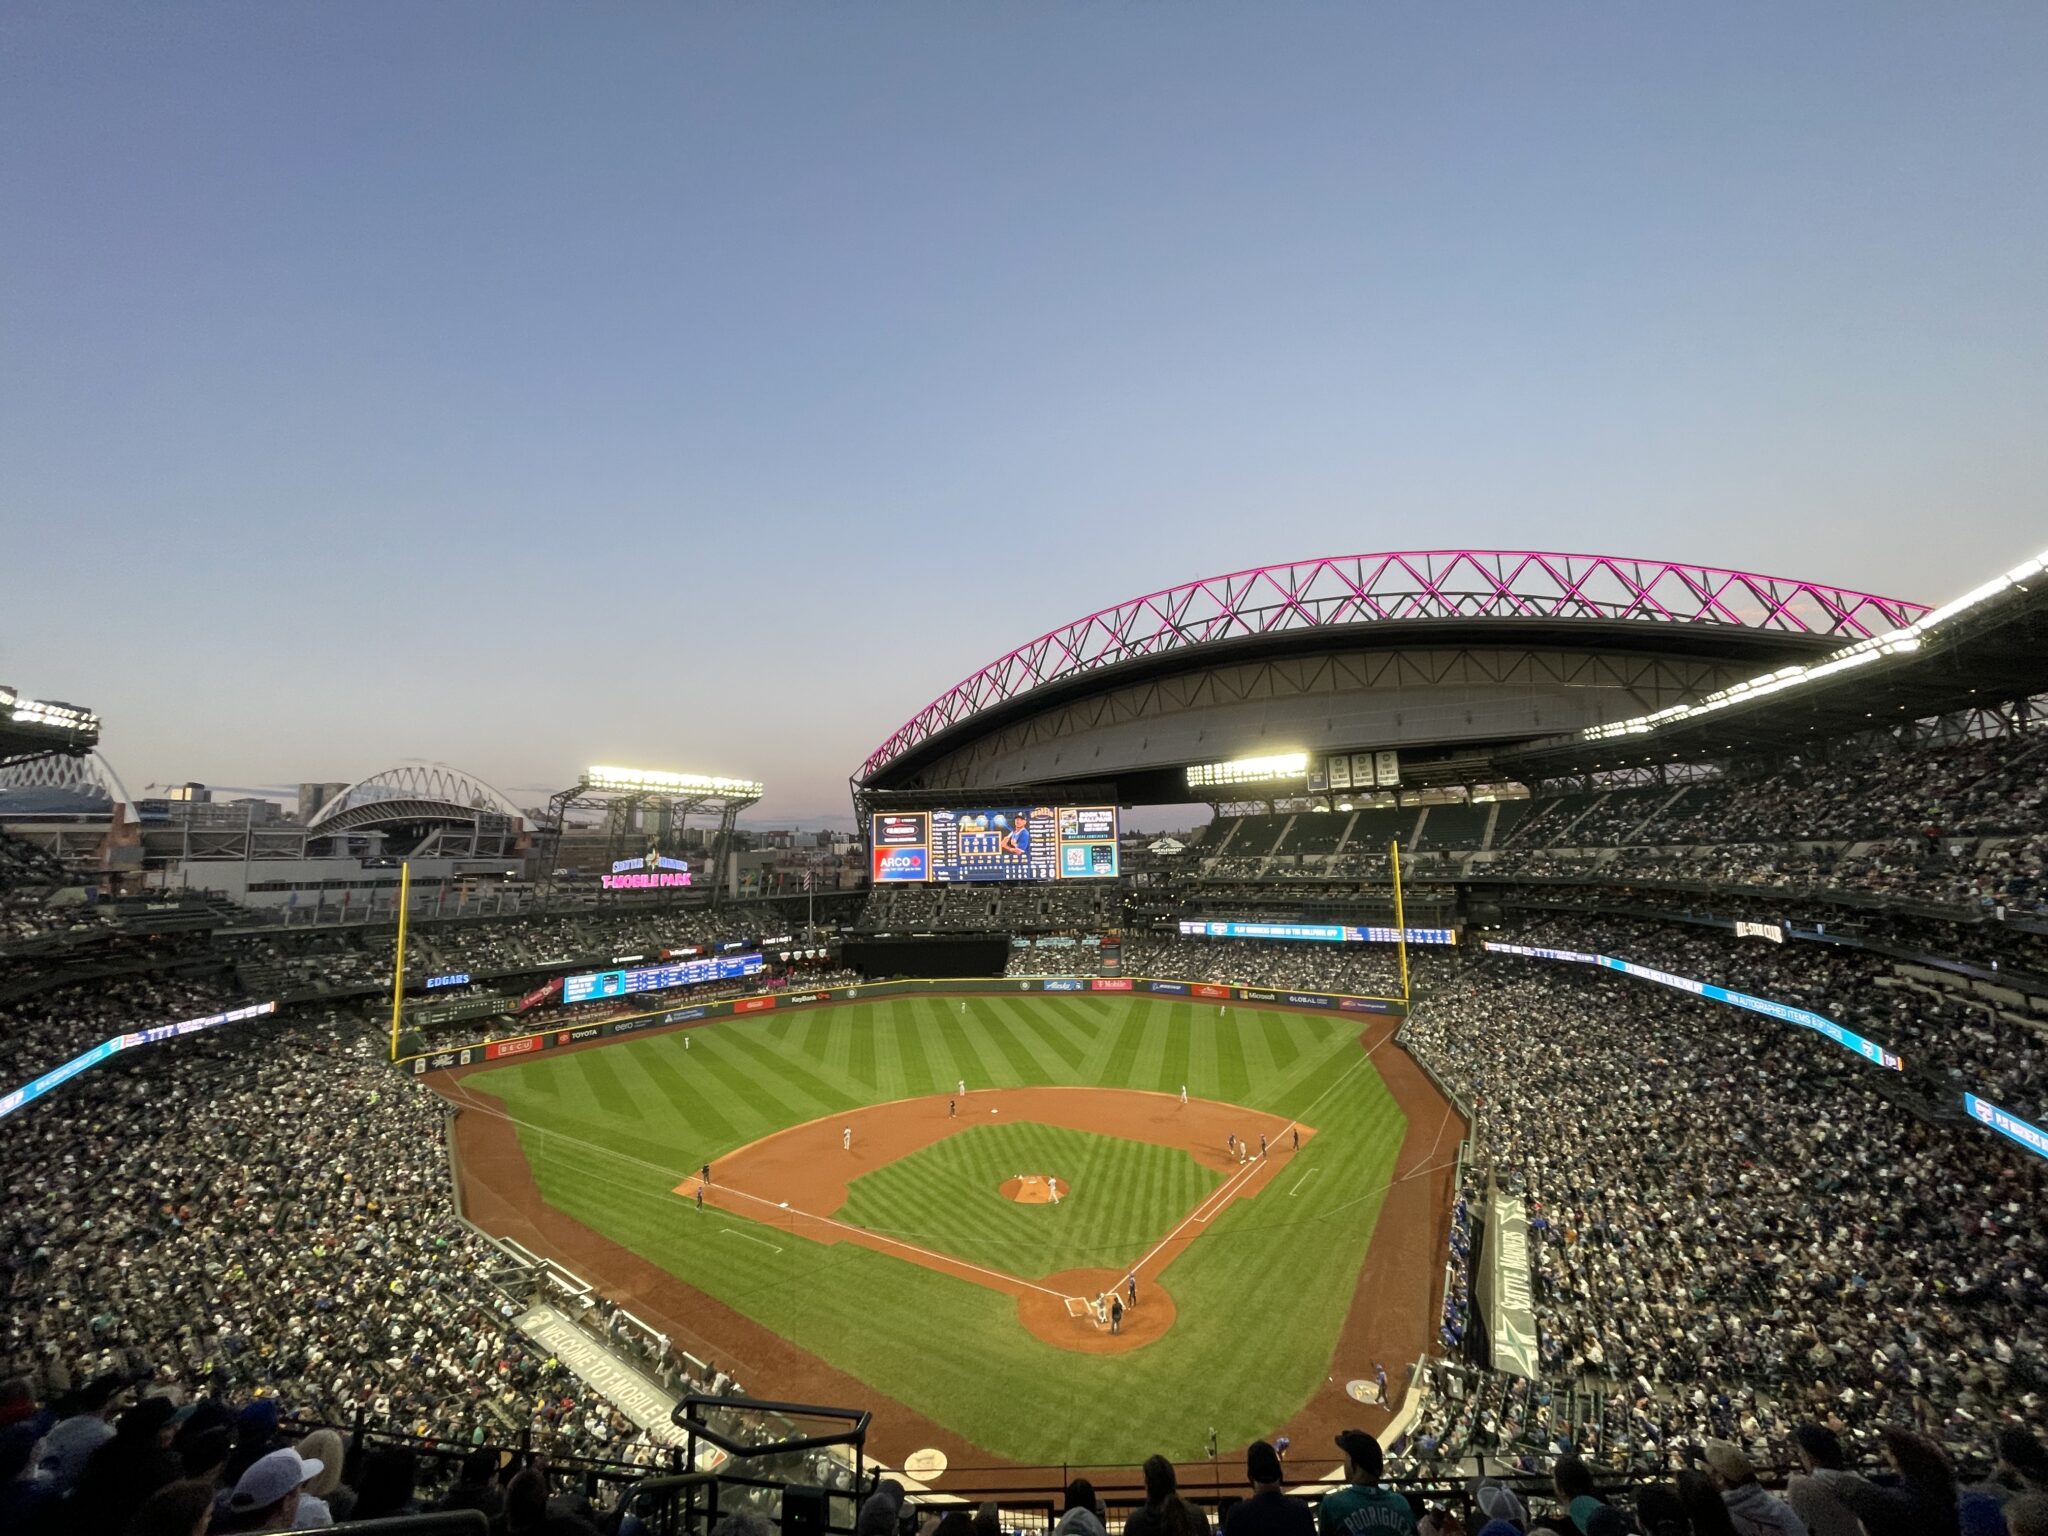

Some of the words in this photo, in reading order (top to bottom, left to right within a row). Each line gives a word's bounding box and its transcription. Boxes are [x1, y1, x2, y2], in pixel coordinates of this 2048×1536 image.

[880, 857, 911, 867] ARCO
[601, 873, 659, 889] T-MOBILE
[660, 872, 692, 886] PARK
[426, 974, 470, 988] EDGARS
[1104, 980, 1126, 988] Mobile
[791, 994, 817, 1003] KeyBank
[1249, 992, 1276, 1001] Microsoft
[1289, 996, 1316, 1004] GLOBAL
[1738, 997, 1787, 1017] AUTOGRAPHED
[1787, 1010, 1811, 1024] ITEMS
[614, 1021, 634, 1032] eero
[571, 1029, 598, 1039] TOYOTA
[501, 1041, 531, 1053] BECU
[1500, 1270, 1531, 1314] SEATTLE
[539, 1322, 594, 1368] WELCOME
[586, 1357, 611, 1379] TO
[601, 1370, 663, 1420] T-MOBILE
